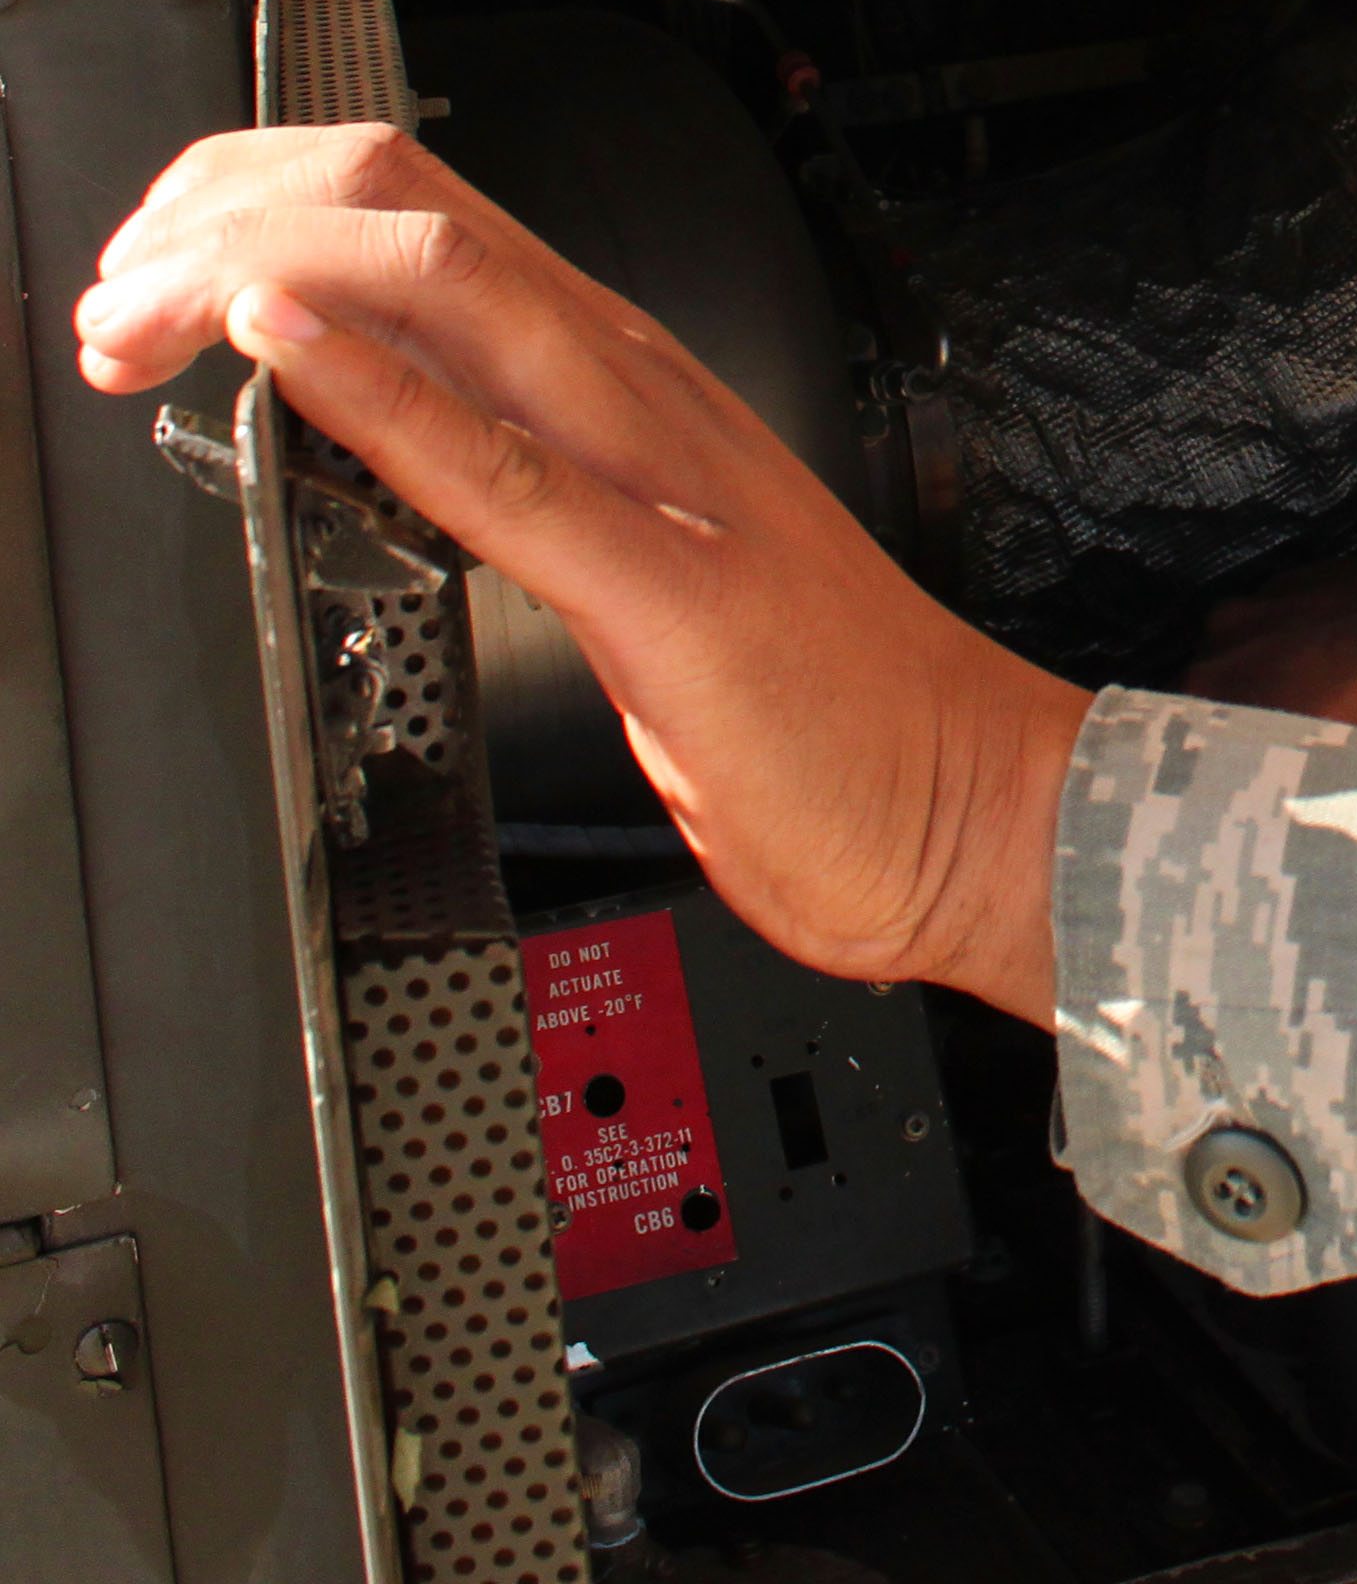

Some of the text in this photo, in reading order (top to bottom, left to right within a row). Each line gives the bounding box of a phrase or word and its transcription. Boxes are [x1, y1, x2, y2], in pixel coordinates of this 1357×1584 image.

[548, 942, 611, 969] DO NOT
[548, 968, 624, 1000] ACTUATE
[536, 1004, 592, 1032] ABOVE
[583, 1127, 693, 1167] 35C2-3-372-11
[597, 1122, 629, 1144] SEE
[555, 1149, 689, 1195] FOR OPERATION
[567, 1171, 680, 1213] INSTRUCTION
[633, 1206, 676, 1235] CB6
